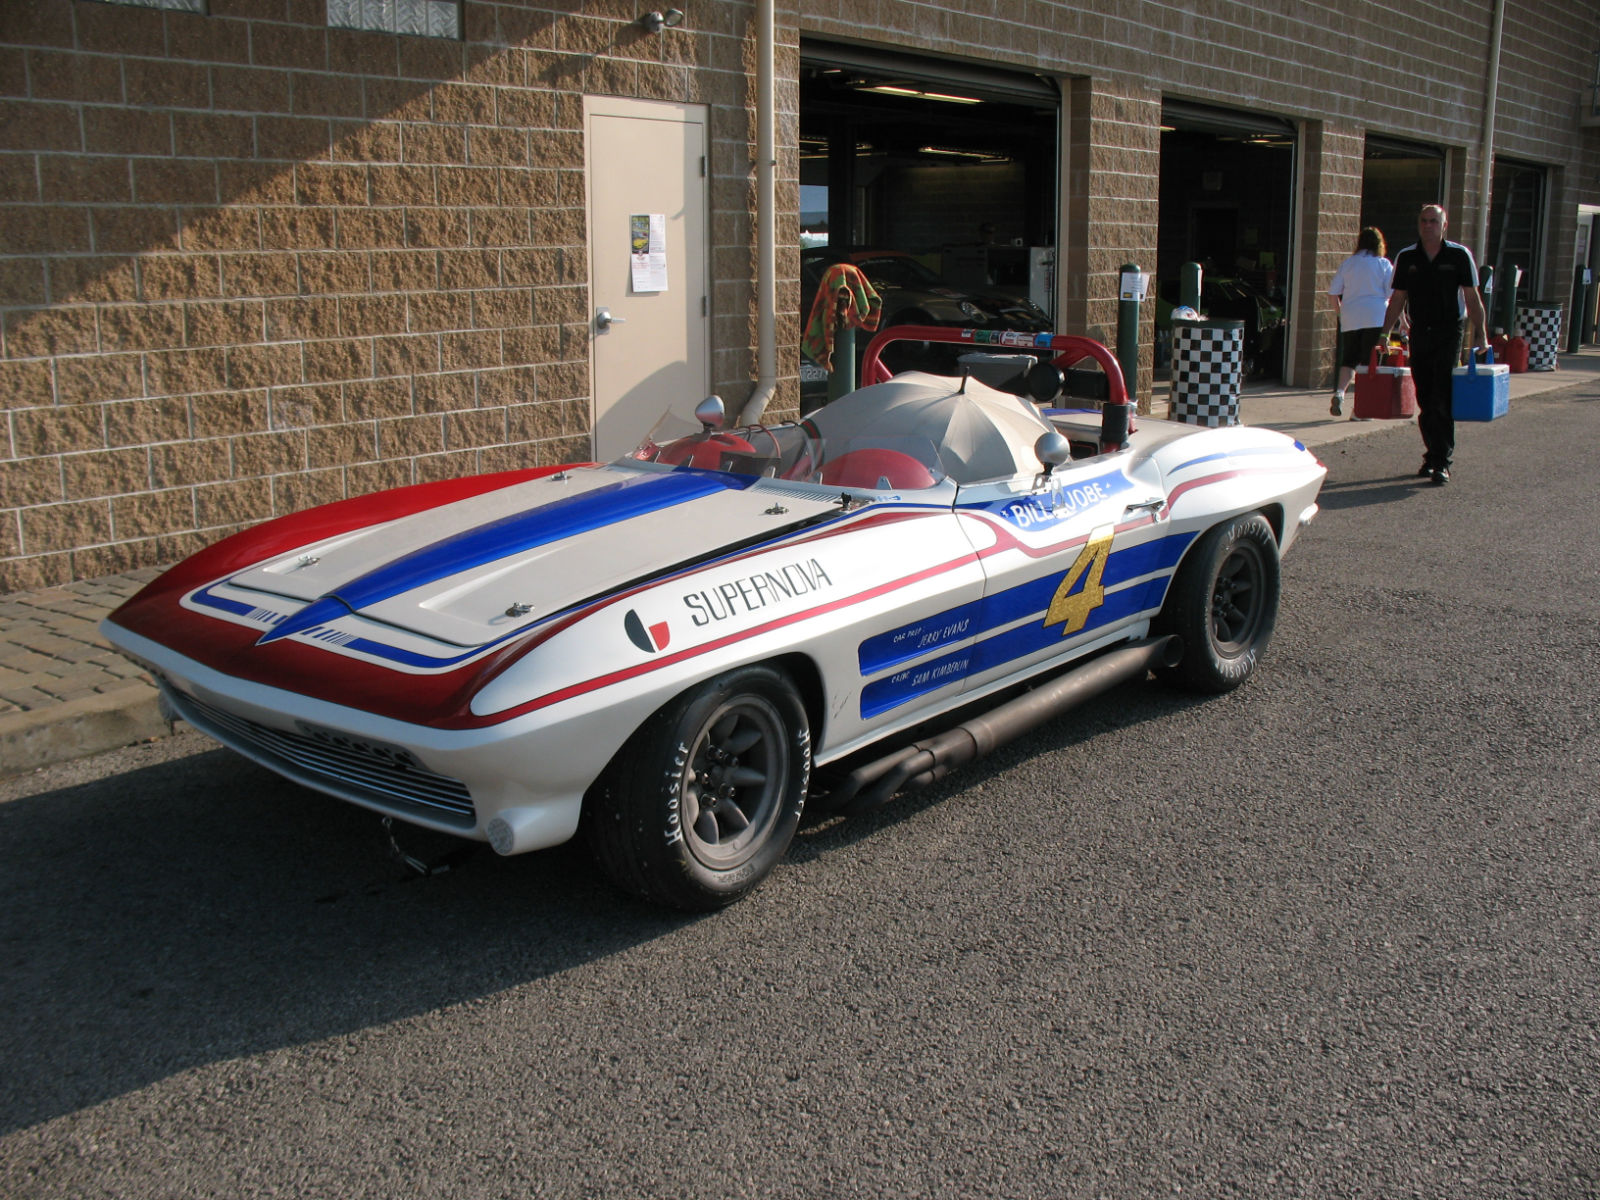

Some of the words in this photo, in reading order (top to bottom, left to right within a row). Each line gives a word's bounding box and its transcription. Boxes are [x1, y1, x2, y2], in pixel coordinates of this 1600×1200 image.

[1011, 500, 1053, 527] BILL
[1064, 482, 1107, 510] JOBE
[683, 558, 833, 627] SUPERNOVA
[1042, 522, 1115, 636] 4
[942, 618, 970, 639] EVANS
[911, 670, 930, 687] SAM
